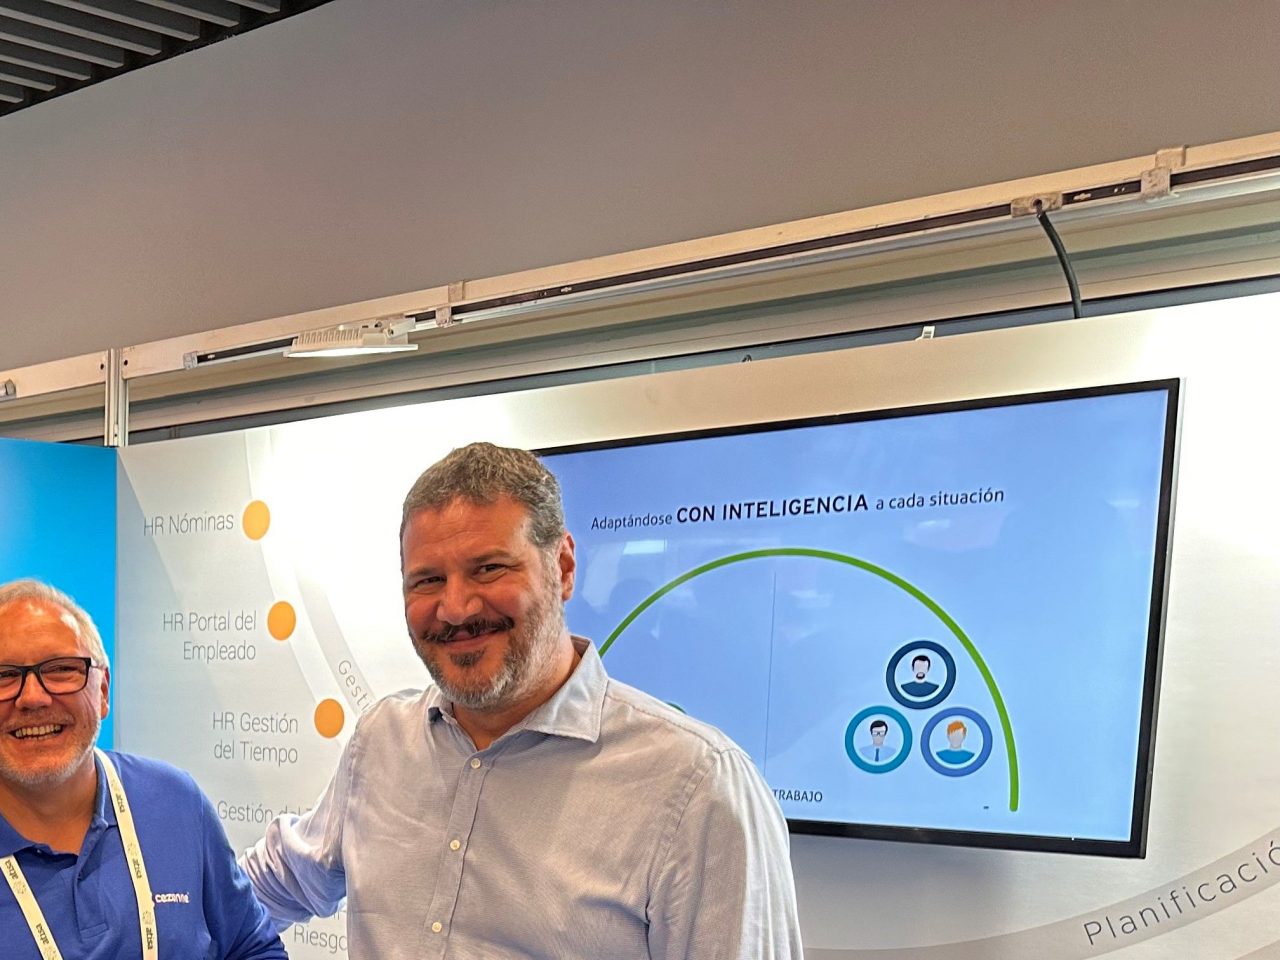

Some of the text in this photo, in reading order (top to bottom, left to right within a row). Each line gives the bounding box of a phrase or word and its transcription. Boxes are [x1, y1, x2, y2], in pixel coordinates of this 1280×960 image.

[590, 487, 1005, 532] Adaptándose CON INTELIGENCIA a cada situación
[144, 511, 234, 536] HR Nóminas
[163, 610, 256, 632] HR Portal del
[183, 640, 256, 664] Empleado
[338, 660, 372, 711] Gesti
[212, 711, 299, 735] HR Gestión
[213, 739, 298, 767] del Tiempo
[217, 800, 274, 824] Gestión
[1083, 840, 1280, 946] Planificació
